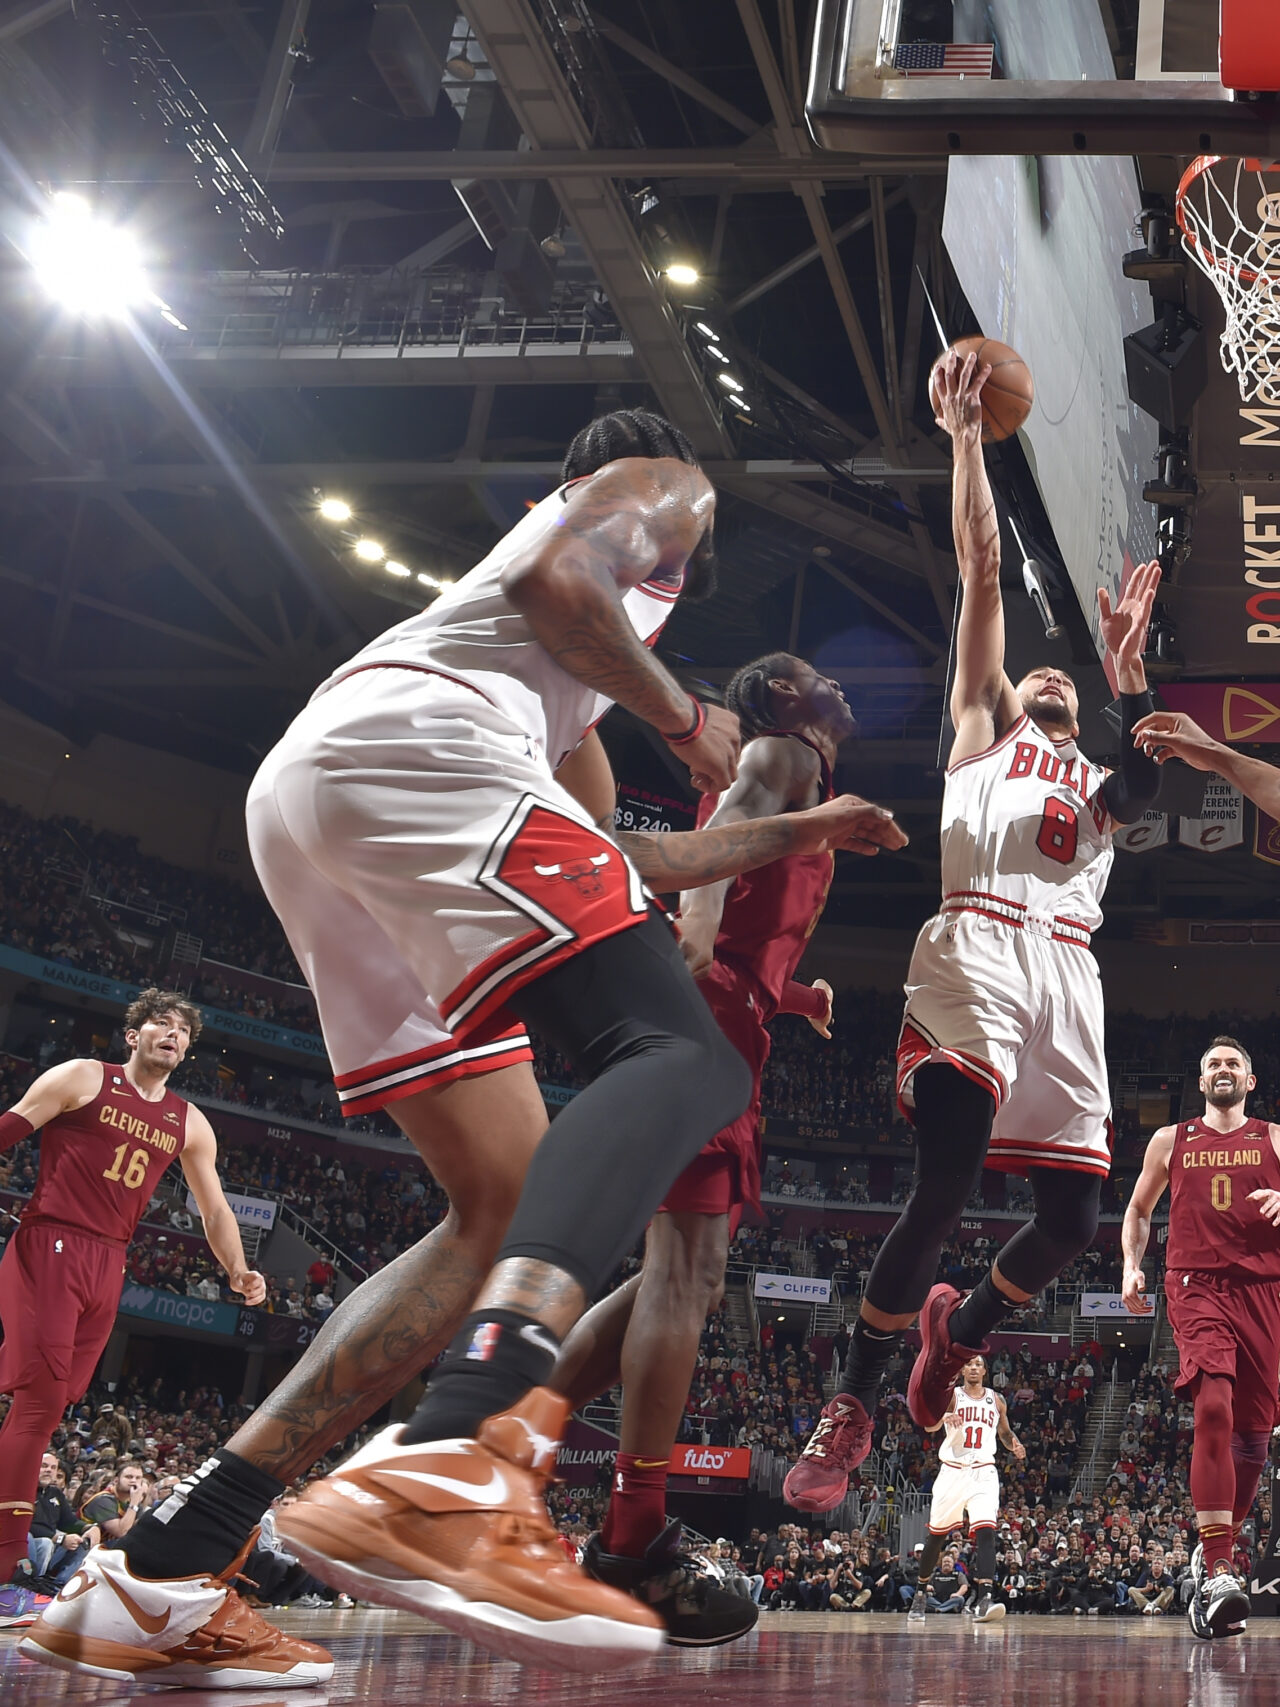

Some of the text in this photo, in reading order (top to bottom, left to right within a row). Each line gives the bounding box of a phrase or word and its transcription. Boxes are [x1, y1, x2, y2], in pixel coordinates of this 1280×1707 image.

[1036, 796, 1078, 865] 8
[43, 965, 110, 996] MANAGE
[214, 1015, 279, 1041] PROTECT
[99, 1105, 178, 1155] CLEVELAND
[267, 1127, 291, 1140] M124
[798, 1126, 839, 1139] $9,240
[102, 1142, 150, 1190] 16
[1183, 1149, 1261, 1168] CLEVELAND
[1211, 1173, 1232, 1211] 0
[232, 1203, 271, 1220] LIFFS
[961, 1221, 983, 1230] M126
[783, 1283, 828, 1296] CLIFFS
[155, 1296, 215, 1325] mcpc
[958, 1407, 994, 1428] BULLS
[964, 1427, 982, 1449] 11
